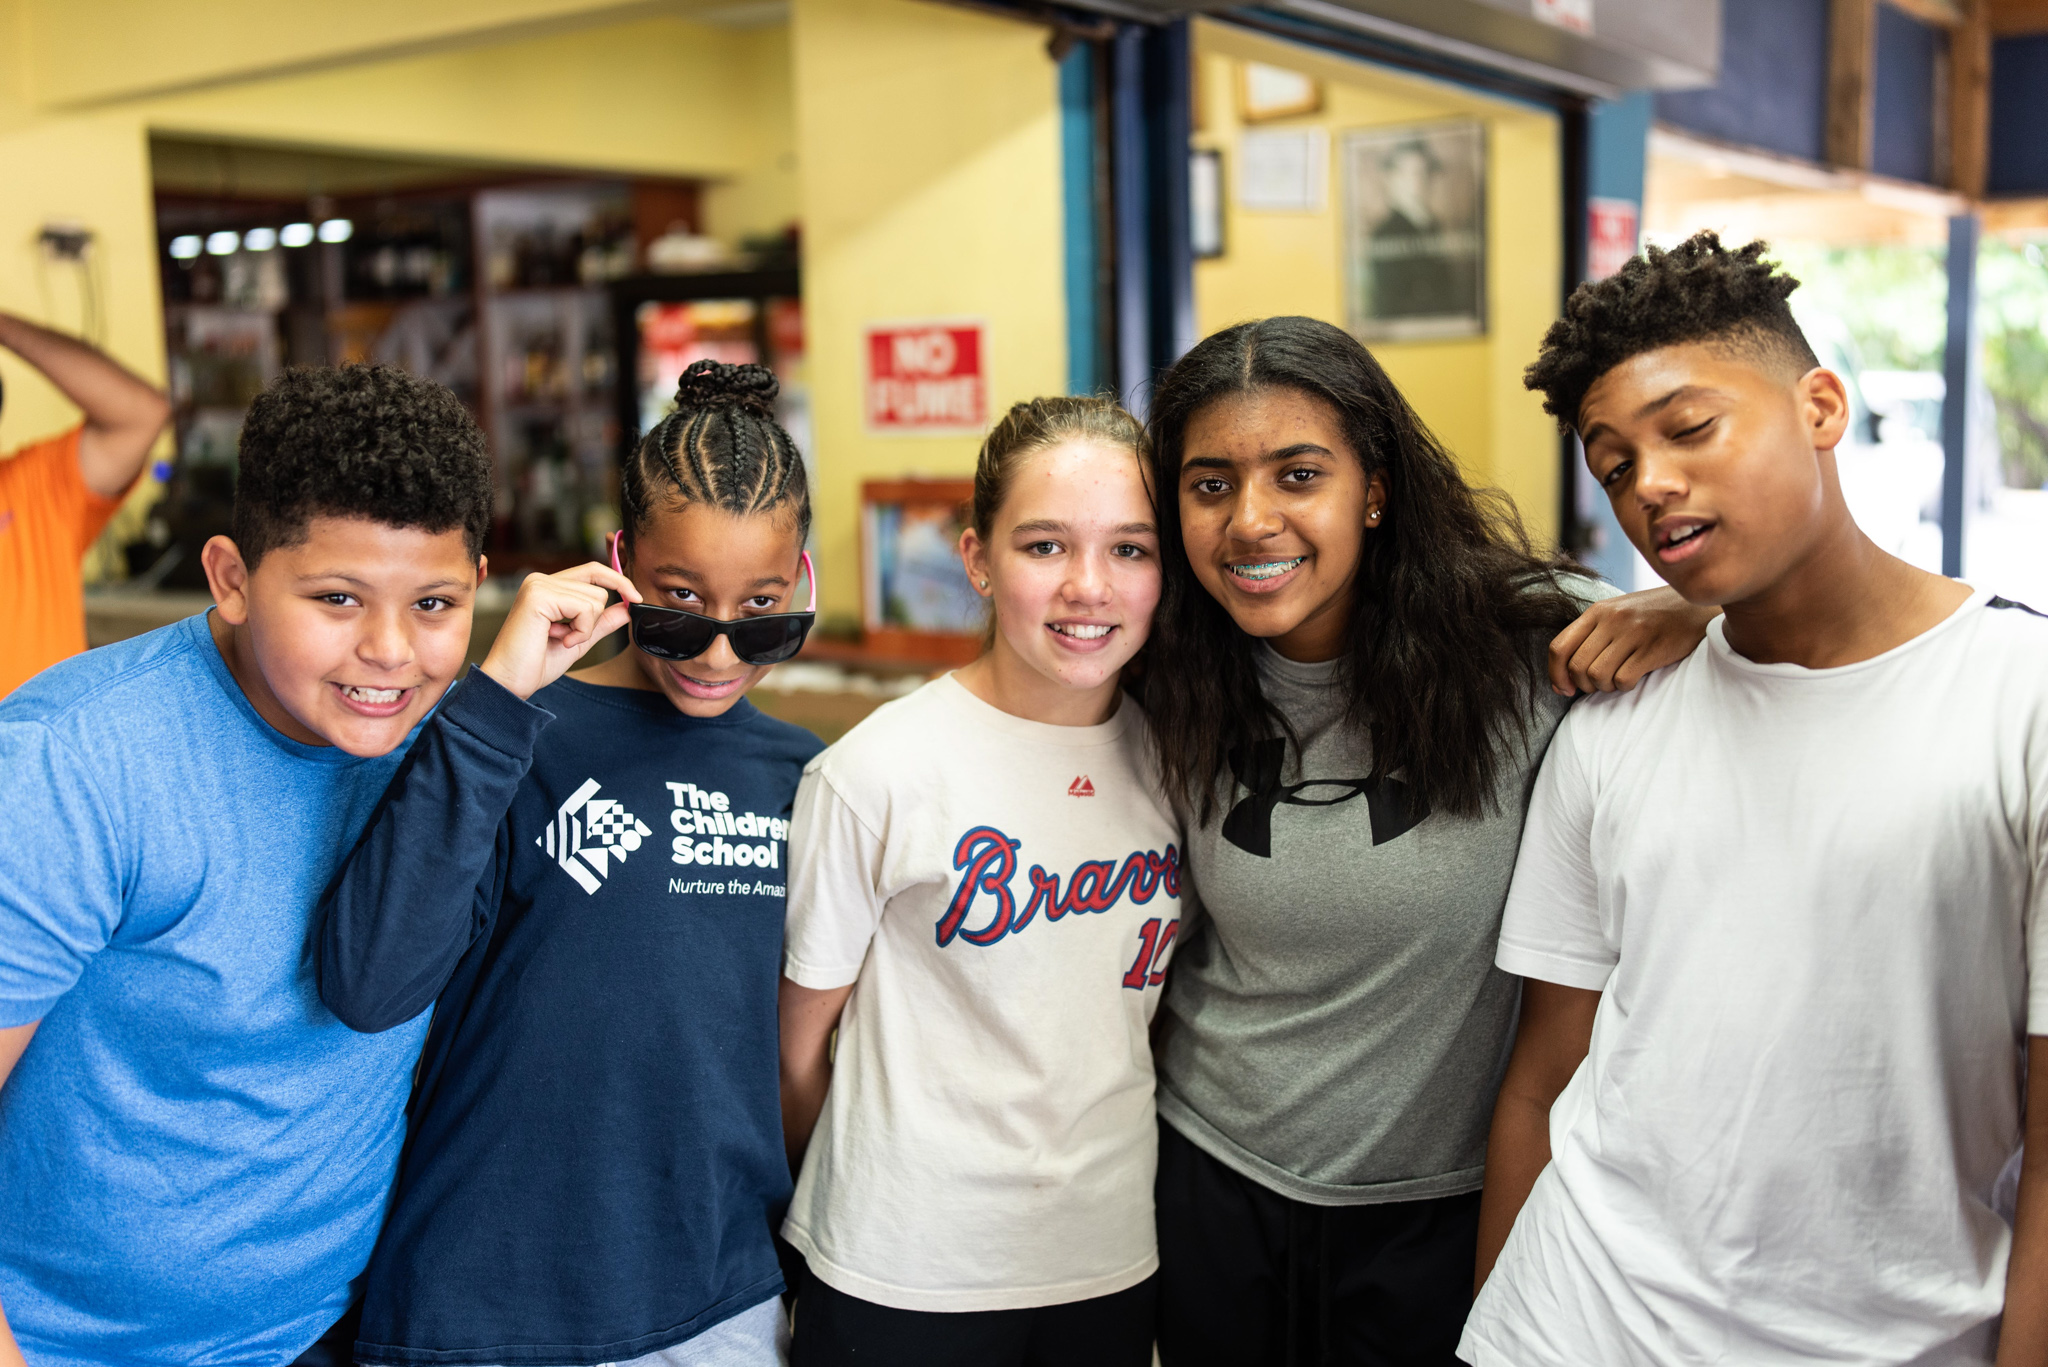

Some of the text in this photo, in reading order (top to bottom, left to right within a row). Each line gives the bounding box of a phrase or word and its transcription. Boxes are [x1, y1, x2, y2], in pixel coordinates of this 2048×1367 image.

[889, 332, 958, 376] NO
[666, 782, 730, 812] The
[671, 835, 779, 869] School
[668, 878, 725, 894] Nurture
[728, 879, 751, 895] the
[935, 825, 1181, 948] Brave
